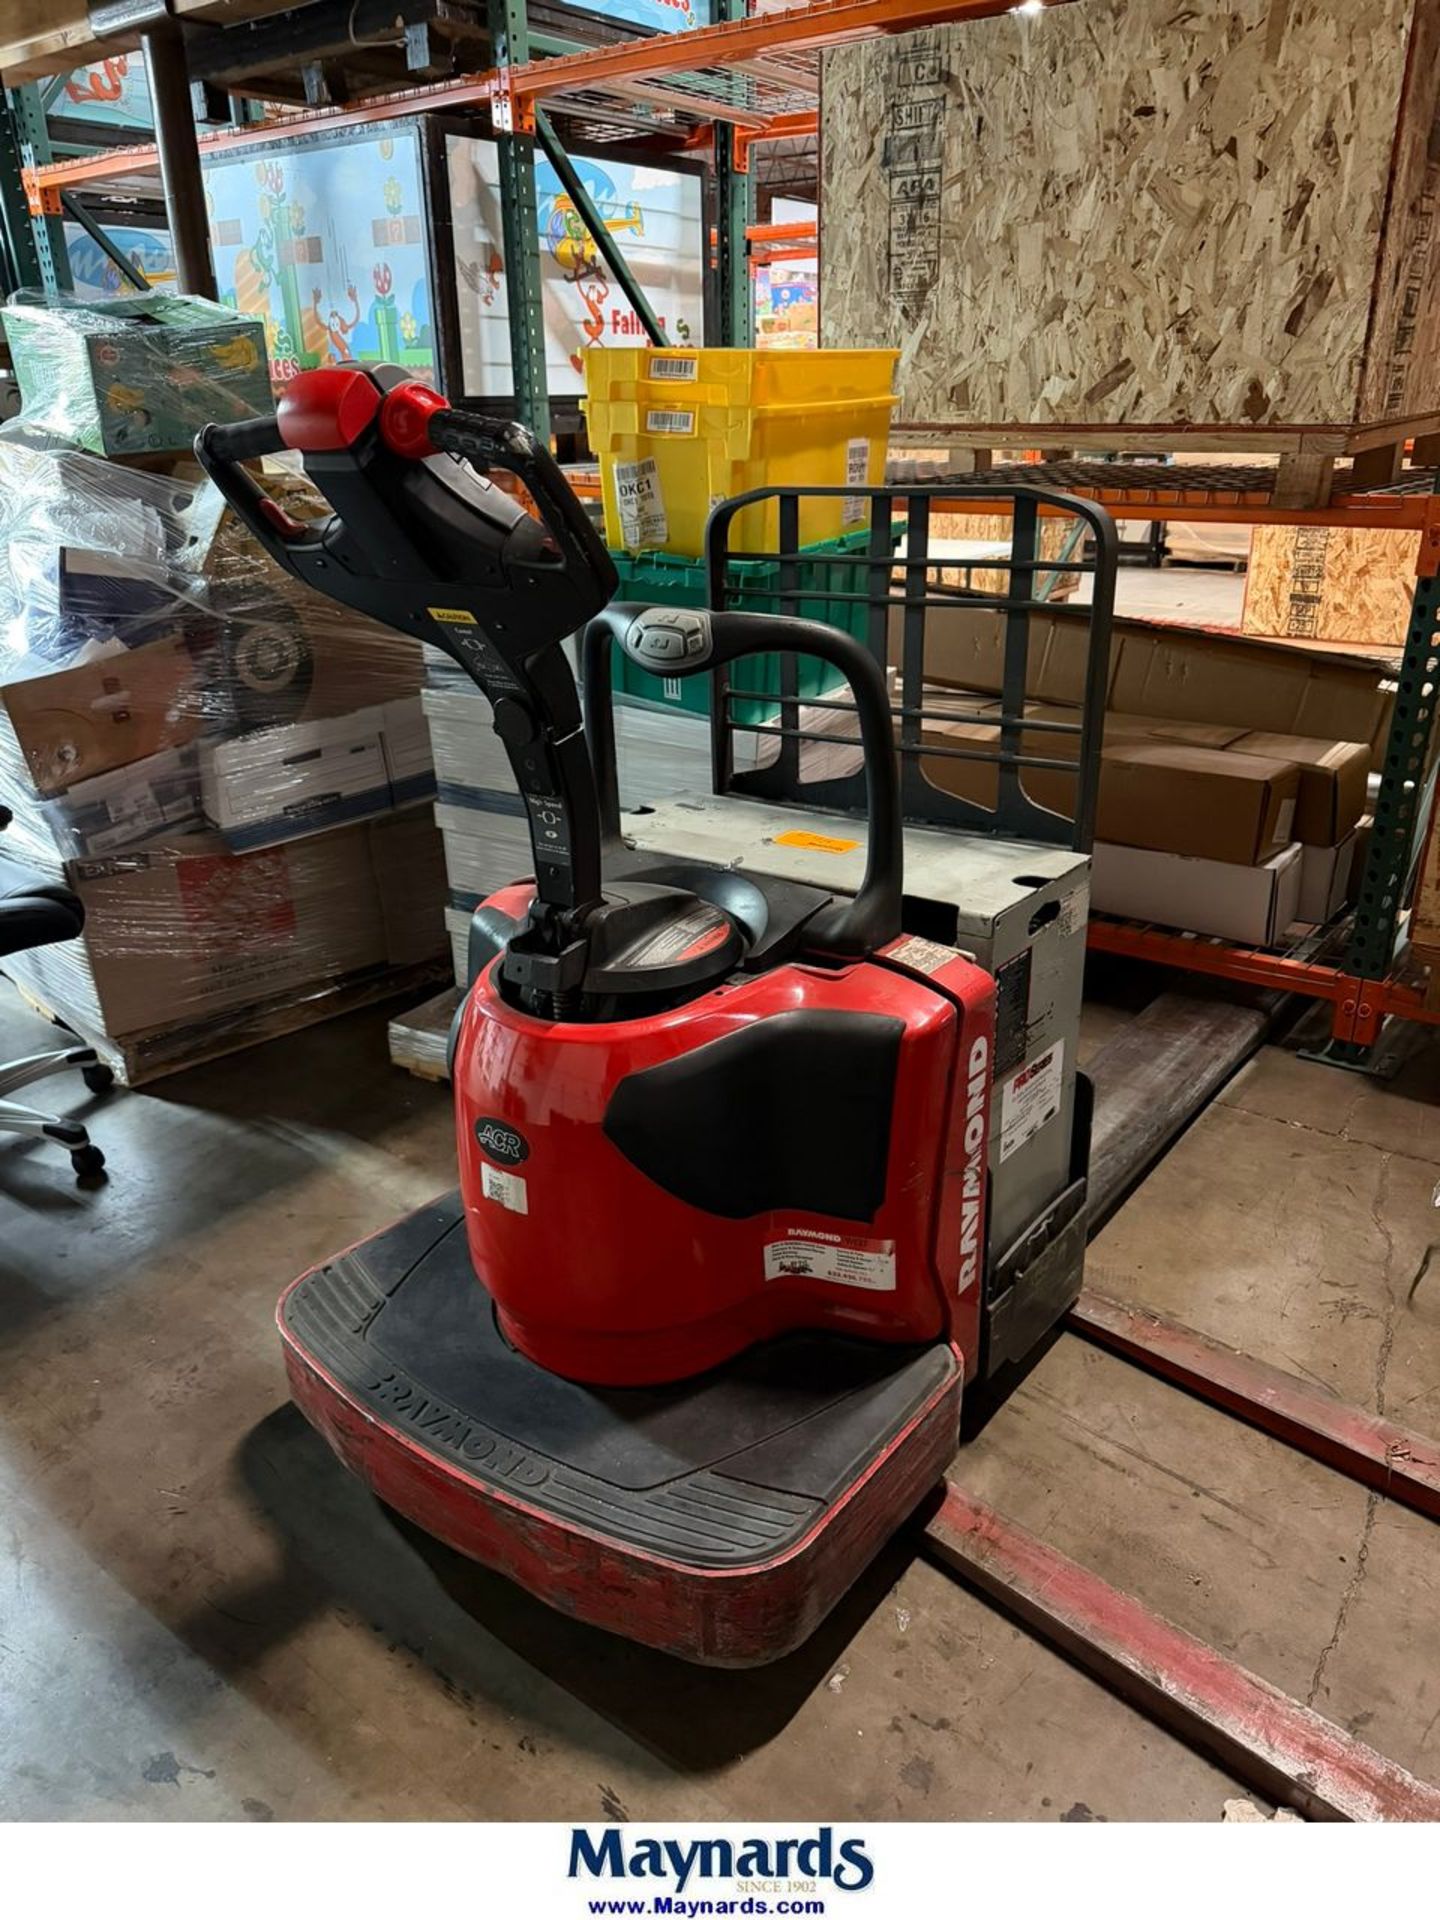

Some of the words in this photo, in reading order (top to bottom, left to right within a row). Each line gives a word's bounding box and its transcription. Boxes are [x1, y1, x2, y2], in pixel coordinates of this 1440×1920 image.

[611, 309, 666, 336] Fallg
[619, 479, 652, 498] OKC1
[478, 1123, 522, 1159] ACR
[957, 1035, 988, 1296] RAYMOND
[787, 1227, 842, 1243] RAYMOND
[378, 1384, 551, 1488] RAYMOND
